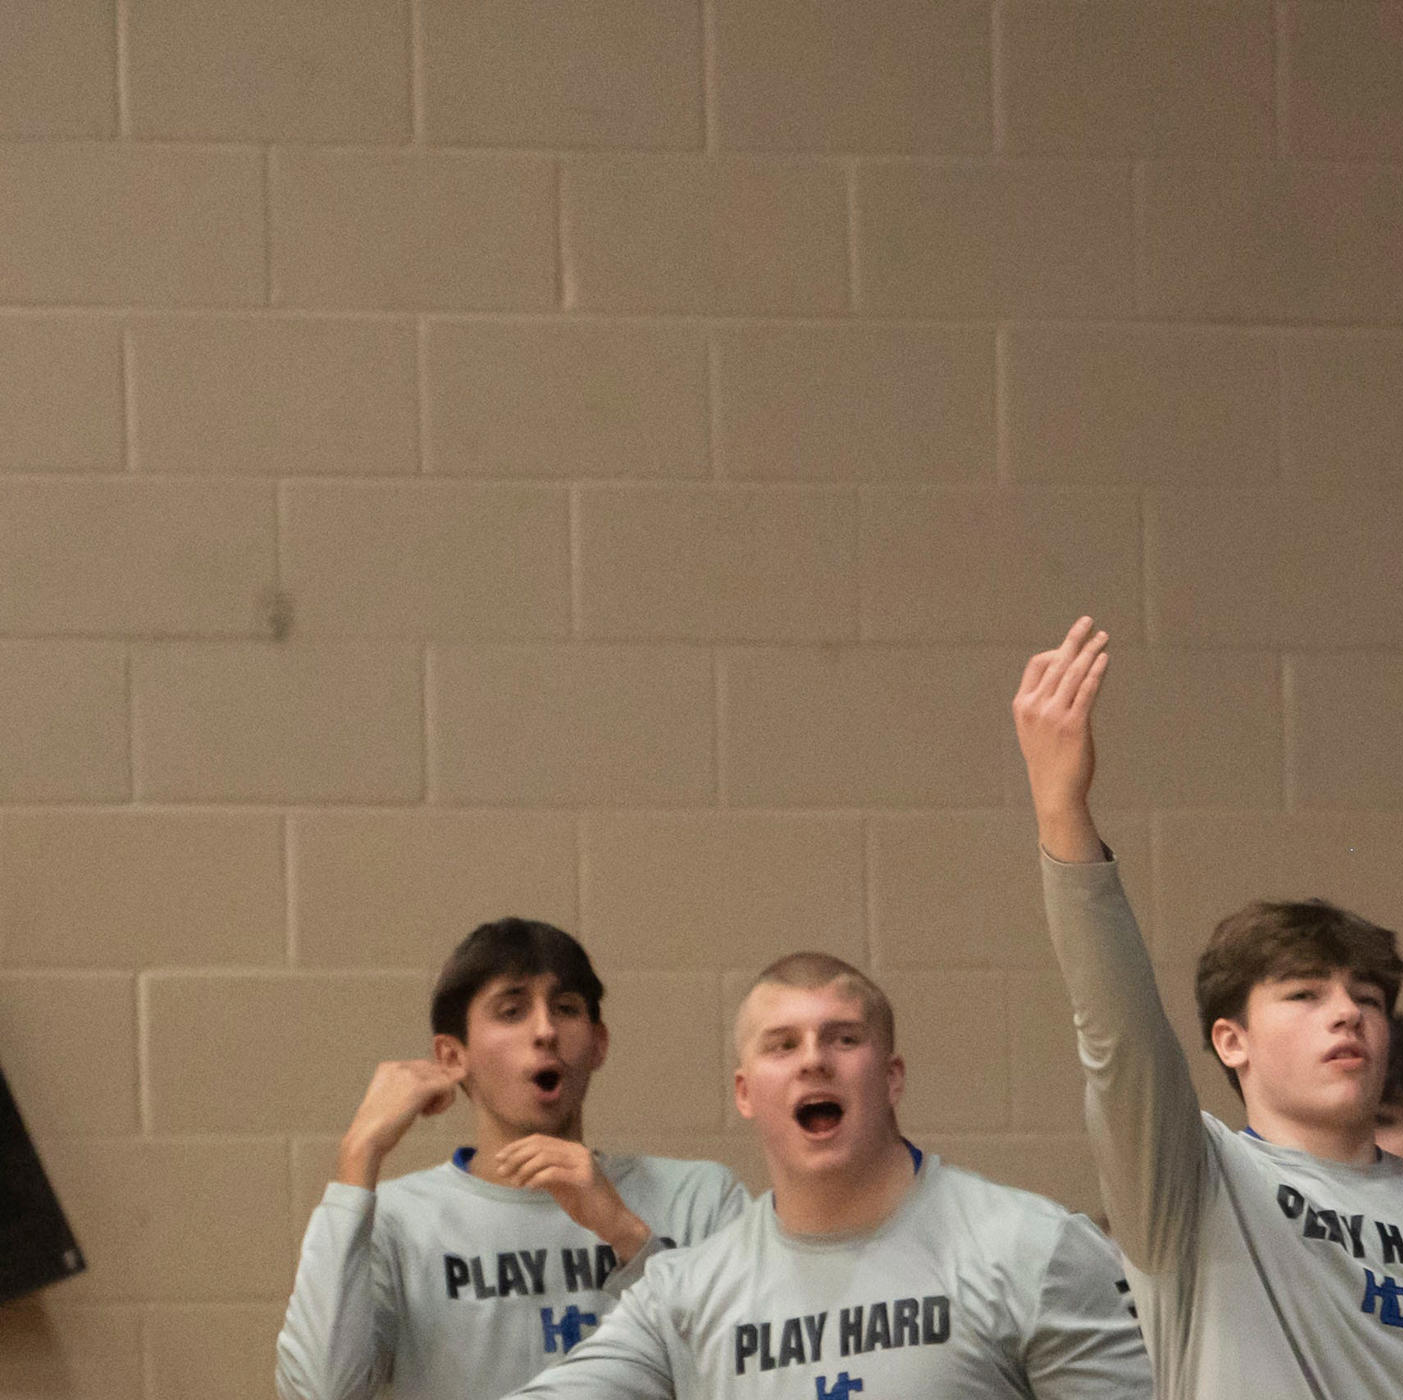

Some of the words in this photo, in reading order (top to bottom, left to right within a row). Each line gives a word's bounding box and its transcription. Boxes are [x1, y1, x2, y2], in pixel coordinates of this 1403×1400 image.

[443, 1249, 547, 1300] PLAY
[736, 1312, 828, 1375] PLAY
[840, 1296, 951, 1357] HARD
